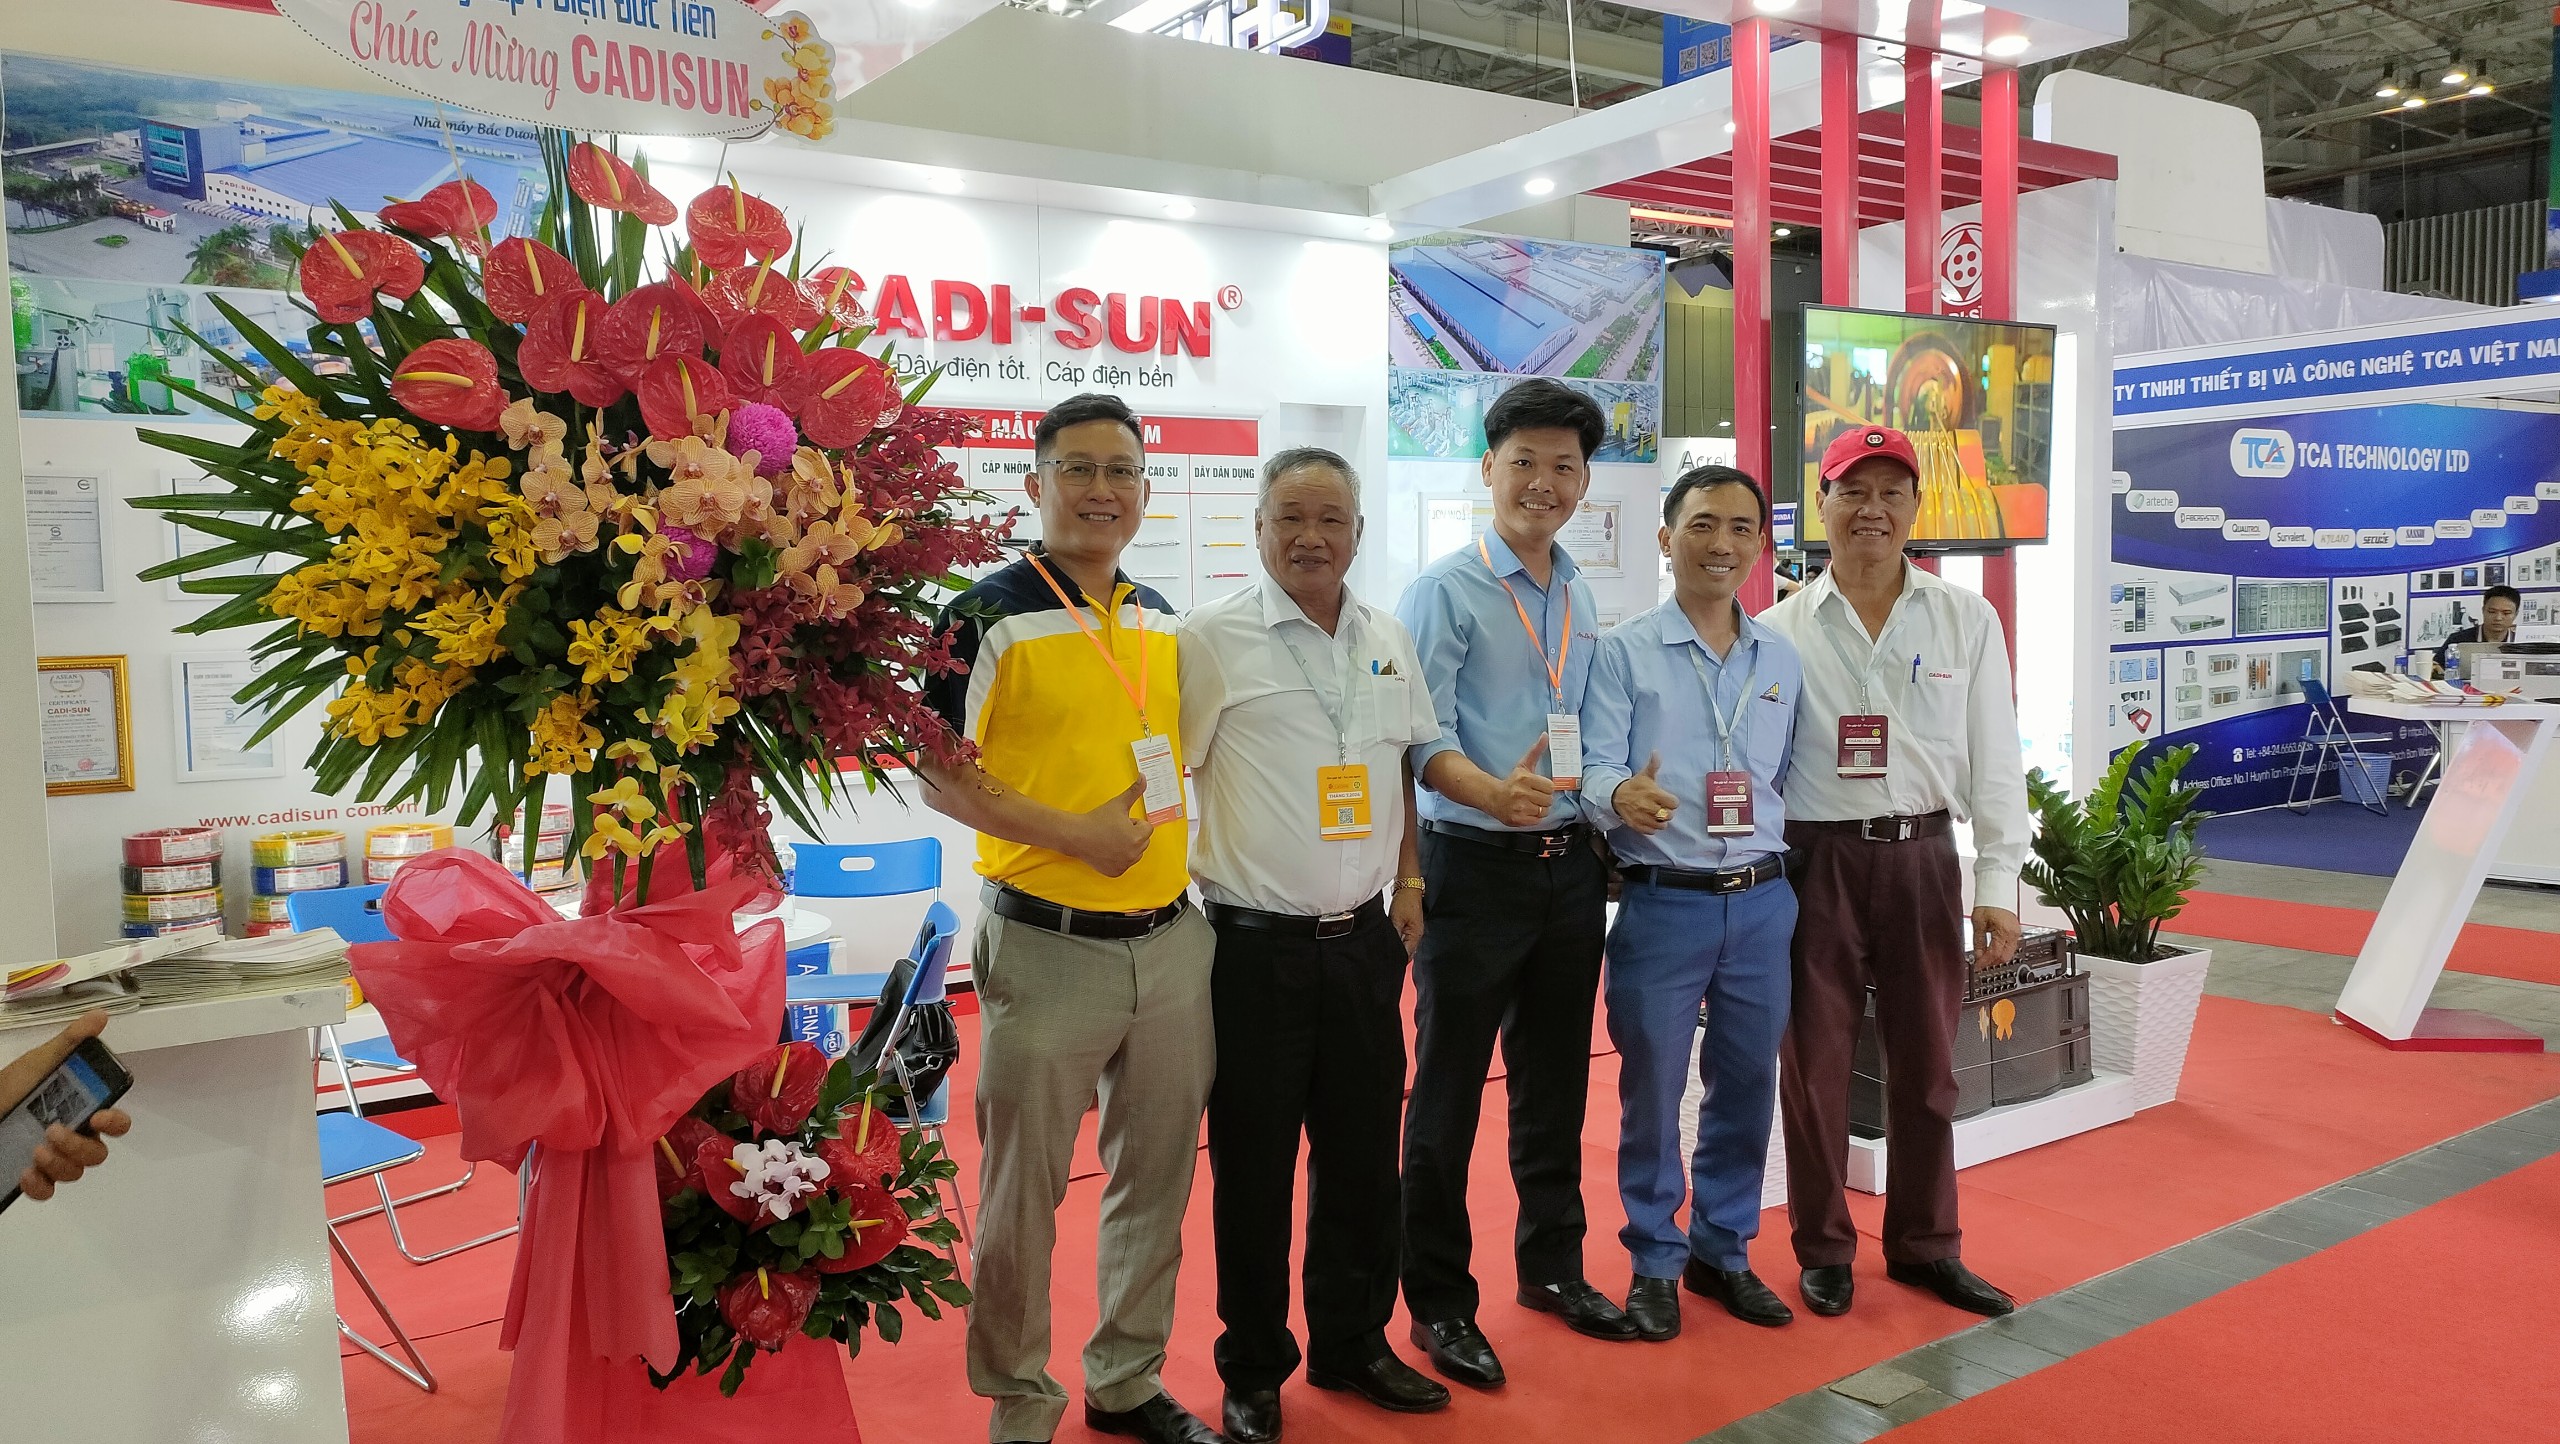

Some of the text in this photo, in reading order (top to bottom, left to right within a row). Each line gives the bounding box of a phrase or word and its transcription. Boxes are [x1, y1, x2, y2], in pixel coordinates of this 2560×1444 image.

[348, 0, 751, 120] Chúc Mừng CADISUN
[413, 115, 441, 129] Nhà
[477, 122, 502, 137] Bắc
[946, 357, 990, 382] điện
[1046, 360, 1085, 387] Cáp
[1092, 364, 1131, 386] điện
[1139, 363, 1174, 388] bền
[2113, 337, 2560, 402] TY TNHH THIẾT BỊ VÀ CÔNG NGHỆ TCA VIỆT NA
[2239, 436, 2286, 469] TCA
[2298, 442, 2470, 473] TCA TECHNOLOGY LTD
[1003, 460, 1031, 474] NHÔM
[1148, 465, 1165, 477] CAO
[1167, 466, 1179, 477] SU
[1194, 465, 1211, 478] DÂY
[1232, 468, 1255, 481] DỤNG
[2145, 496, 2174, 507] arteche
[47, 706, 91, 715] CADI-SUN
